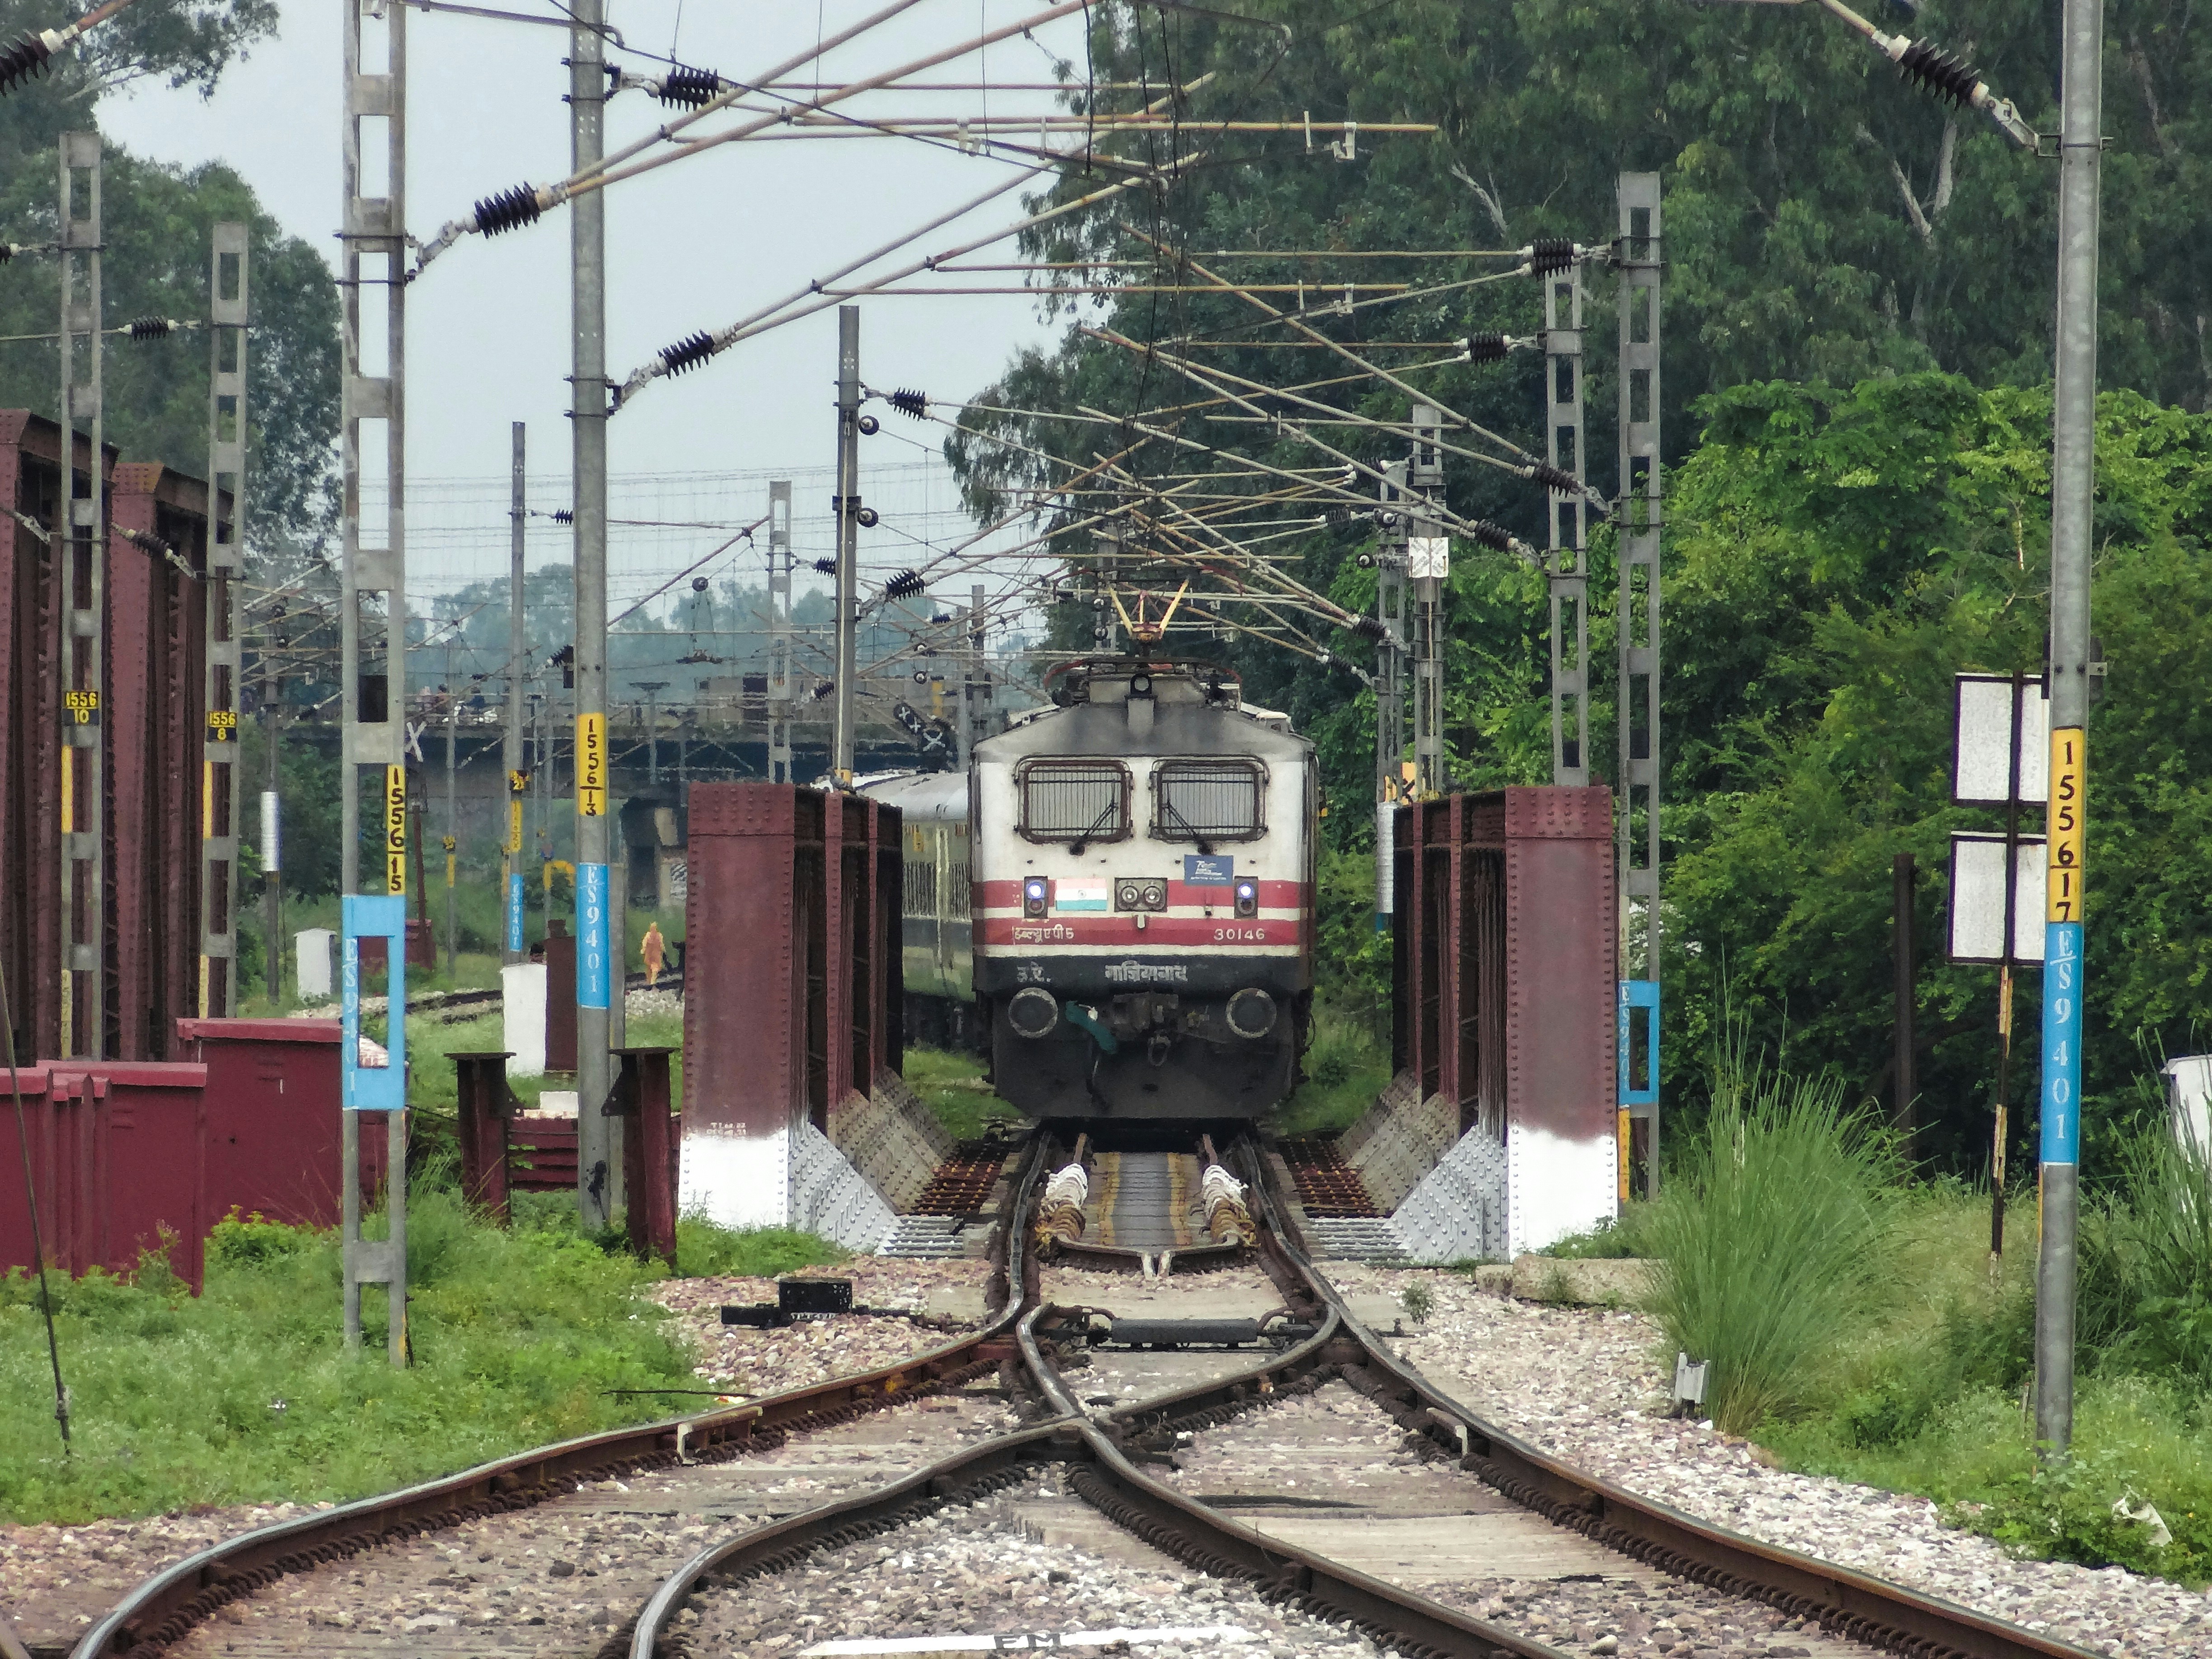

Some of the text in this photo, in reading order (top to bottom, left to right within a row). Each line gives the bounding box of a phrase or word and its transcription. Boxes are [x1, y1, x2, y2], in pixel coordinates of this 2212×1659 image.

[66, 692, 96, 706] 1556
[74, 709, 89, 723] 10
[209, 712, 235, 726] 1556
[217, 728, 226, 740] 8
[587, 718, 599, 785] 1556
[390, 767, 404, 847] 1556
[2057, 740, 2074, 867] 1556
[1214, 928, 1265, 941] 30146
